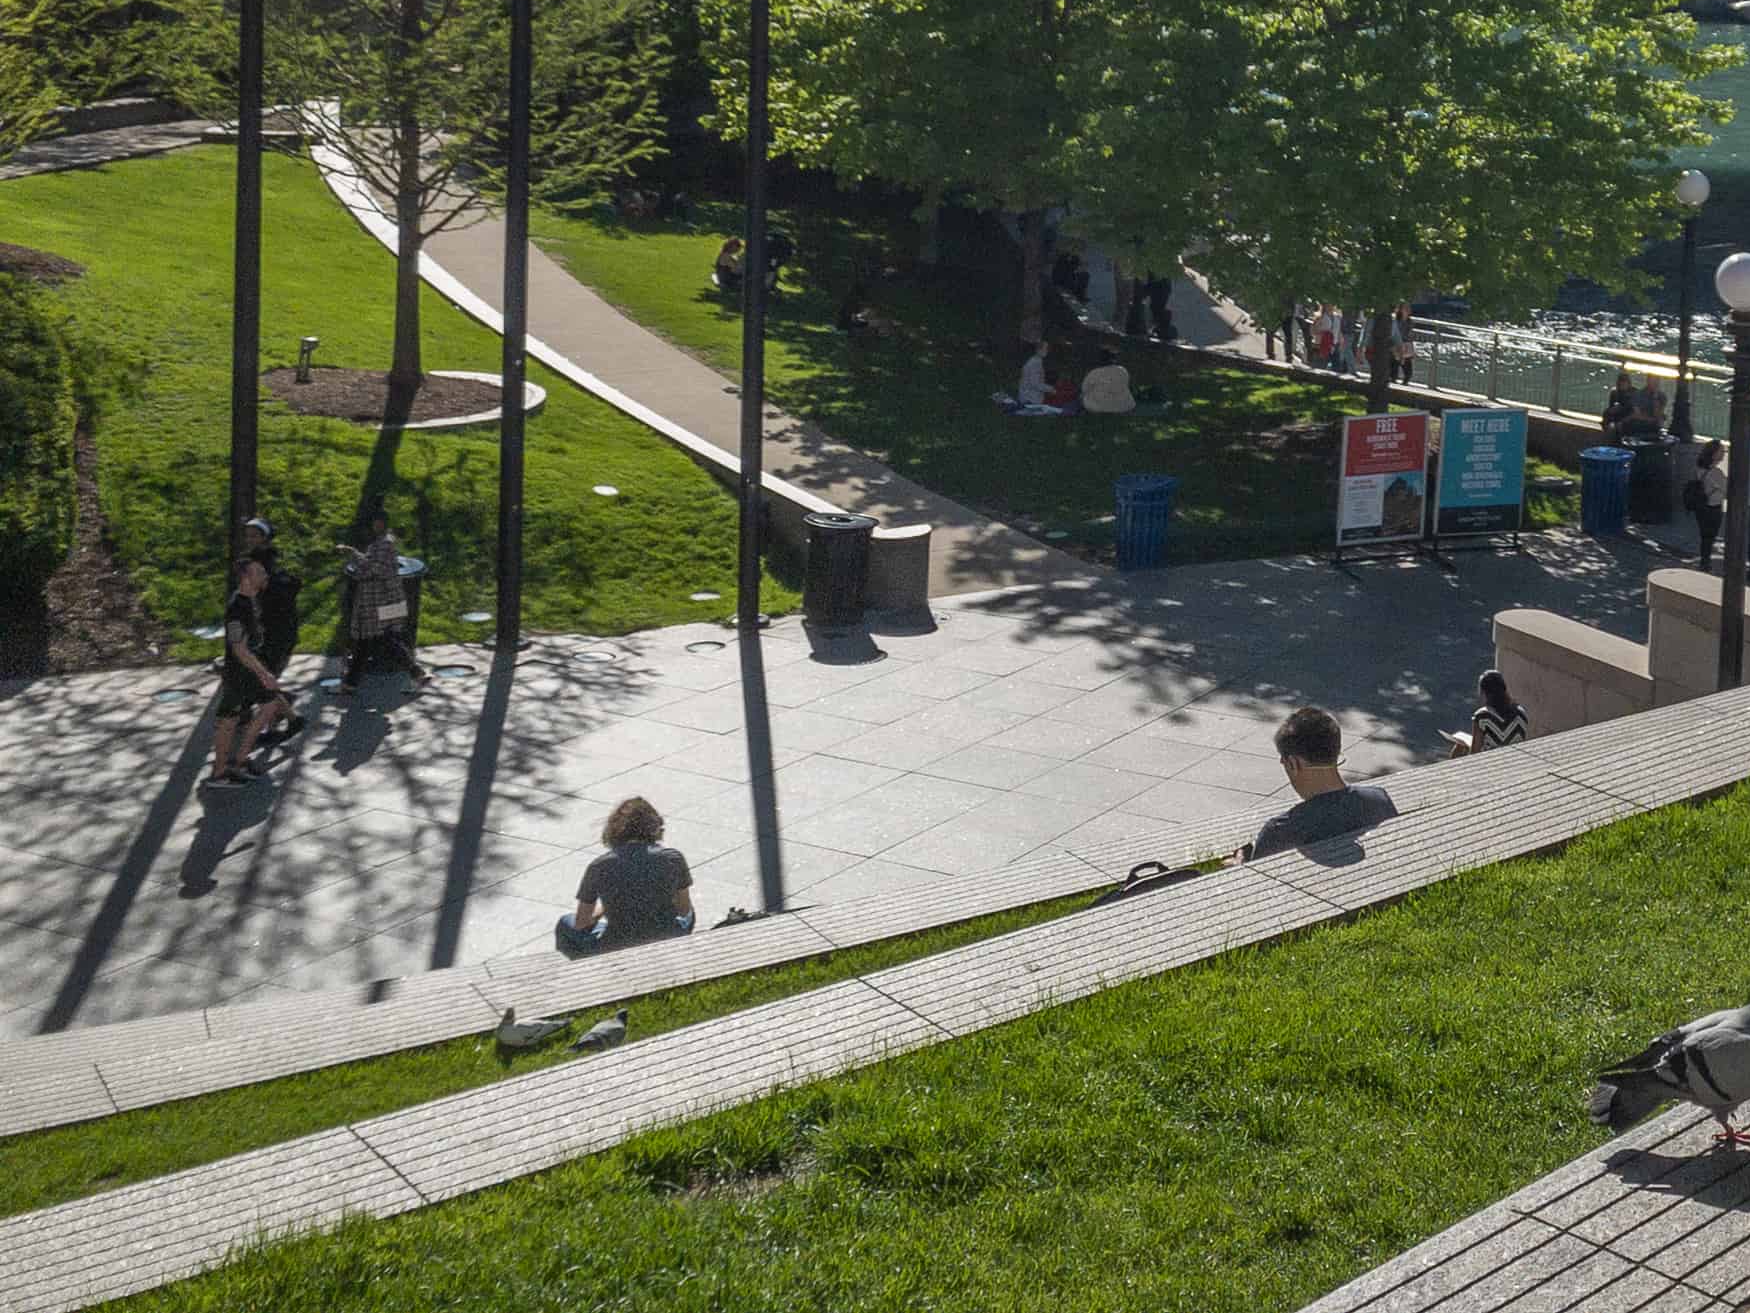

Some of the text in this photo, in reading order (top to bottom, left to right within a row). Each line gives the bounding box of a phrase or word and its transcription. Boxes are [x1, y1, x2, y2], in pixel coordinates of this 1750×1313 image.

[1376, 418, 1399, 434] FREE
[1461, 417, 1511, 434] MEET HERE
